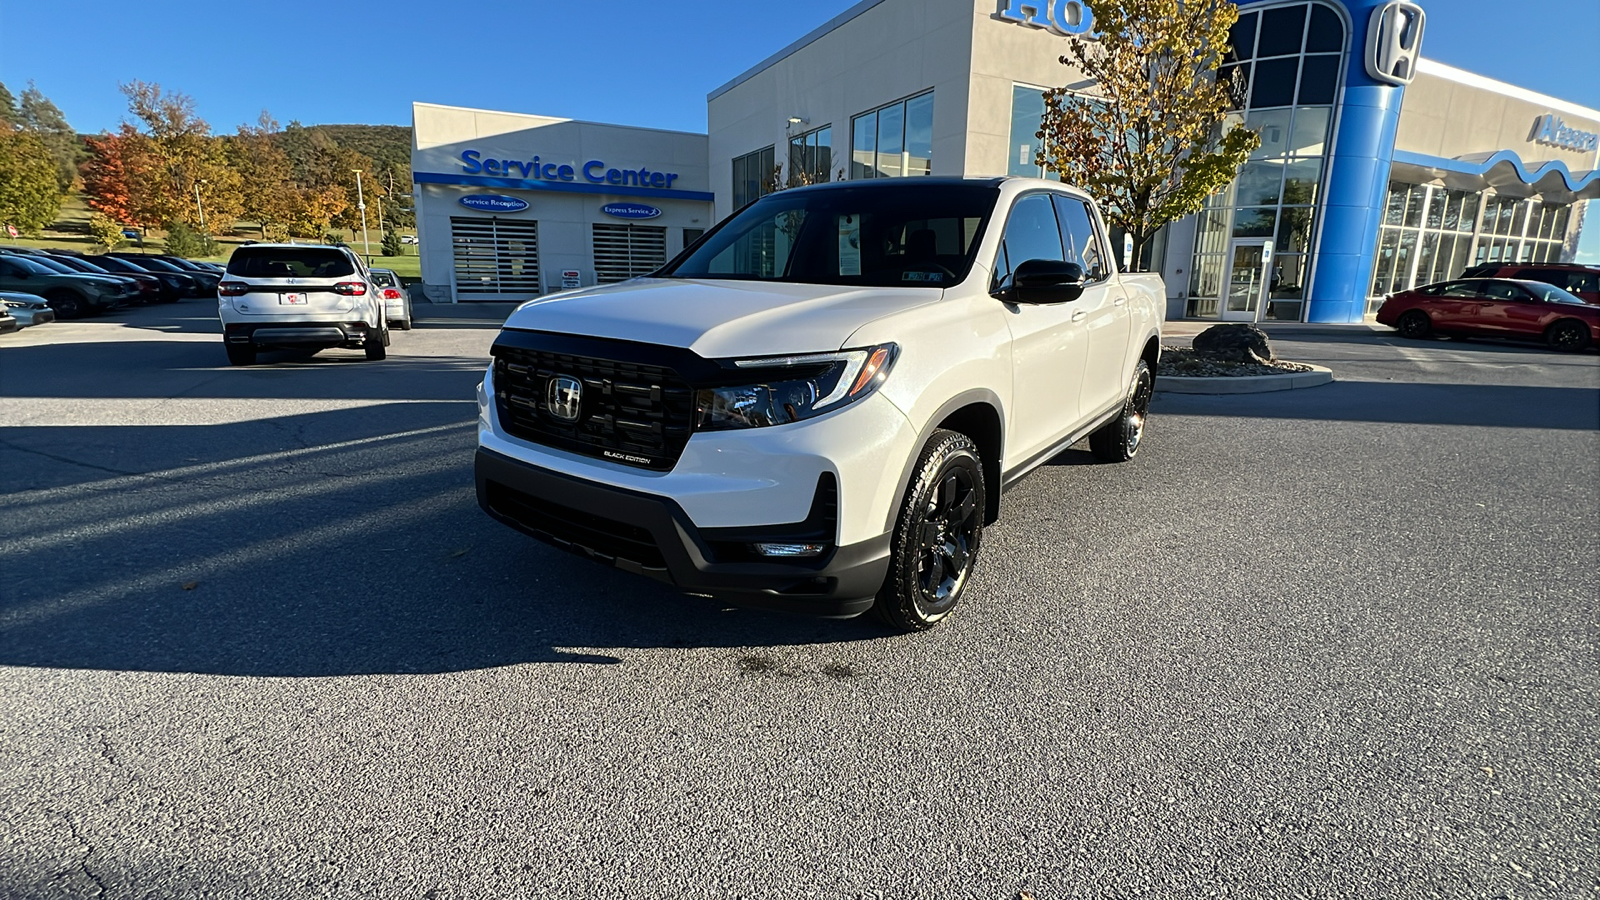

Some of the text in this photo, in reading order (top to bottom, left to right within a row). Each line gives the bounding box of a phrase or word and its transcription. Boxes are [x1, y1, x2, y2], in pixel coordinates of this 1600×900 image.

[461, 149, 679, 188] Service Center
[463, 197, 525, 208] Service Reception
[603, 450, 651, 464] BLACK EDITION
